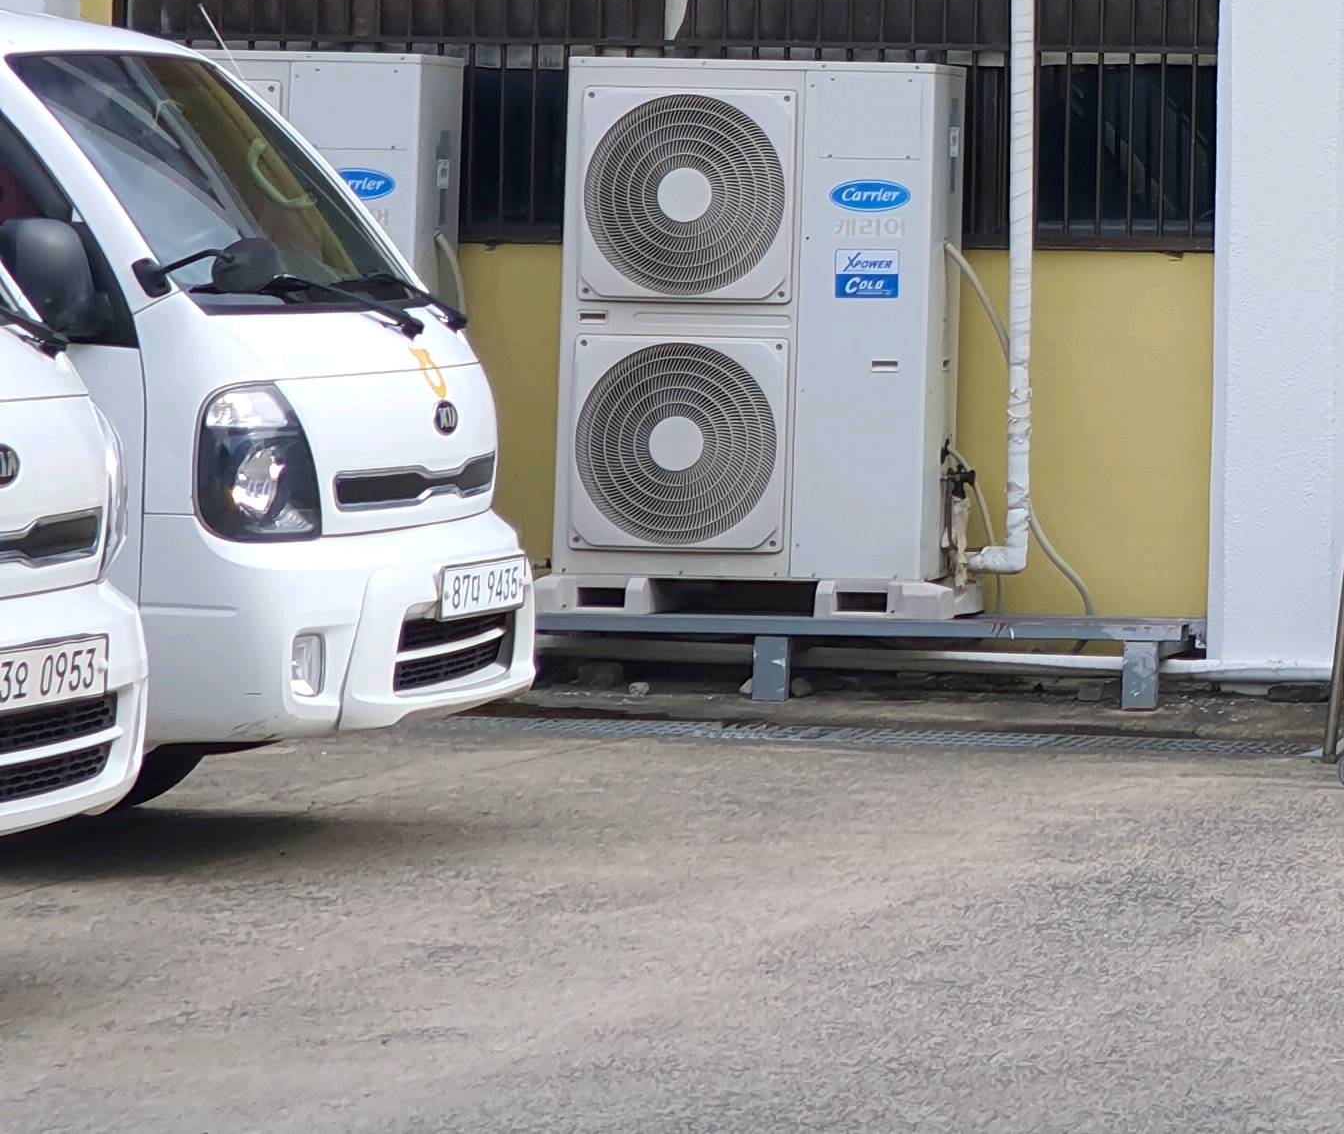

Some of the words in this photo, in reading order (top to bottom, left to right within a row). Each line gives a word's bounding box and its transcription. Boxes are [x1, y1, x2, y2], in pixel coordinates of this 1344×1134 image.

[346, 176, 385, 191] rrier
[841, 186, 900, 202] Carrier
[833, 218, 905, 237] 캐리어
[487, 566, 518, 604] 9435
[40, 647, 97, 696] 0953
